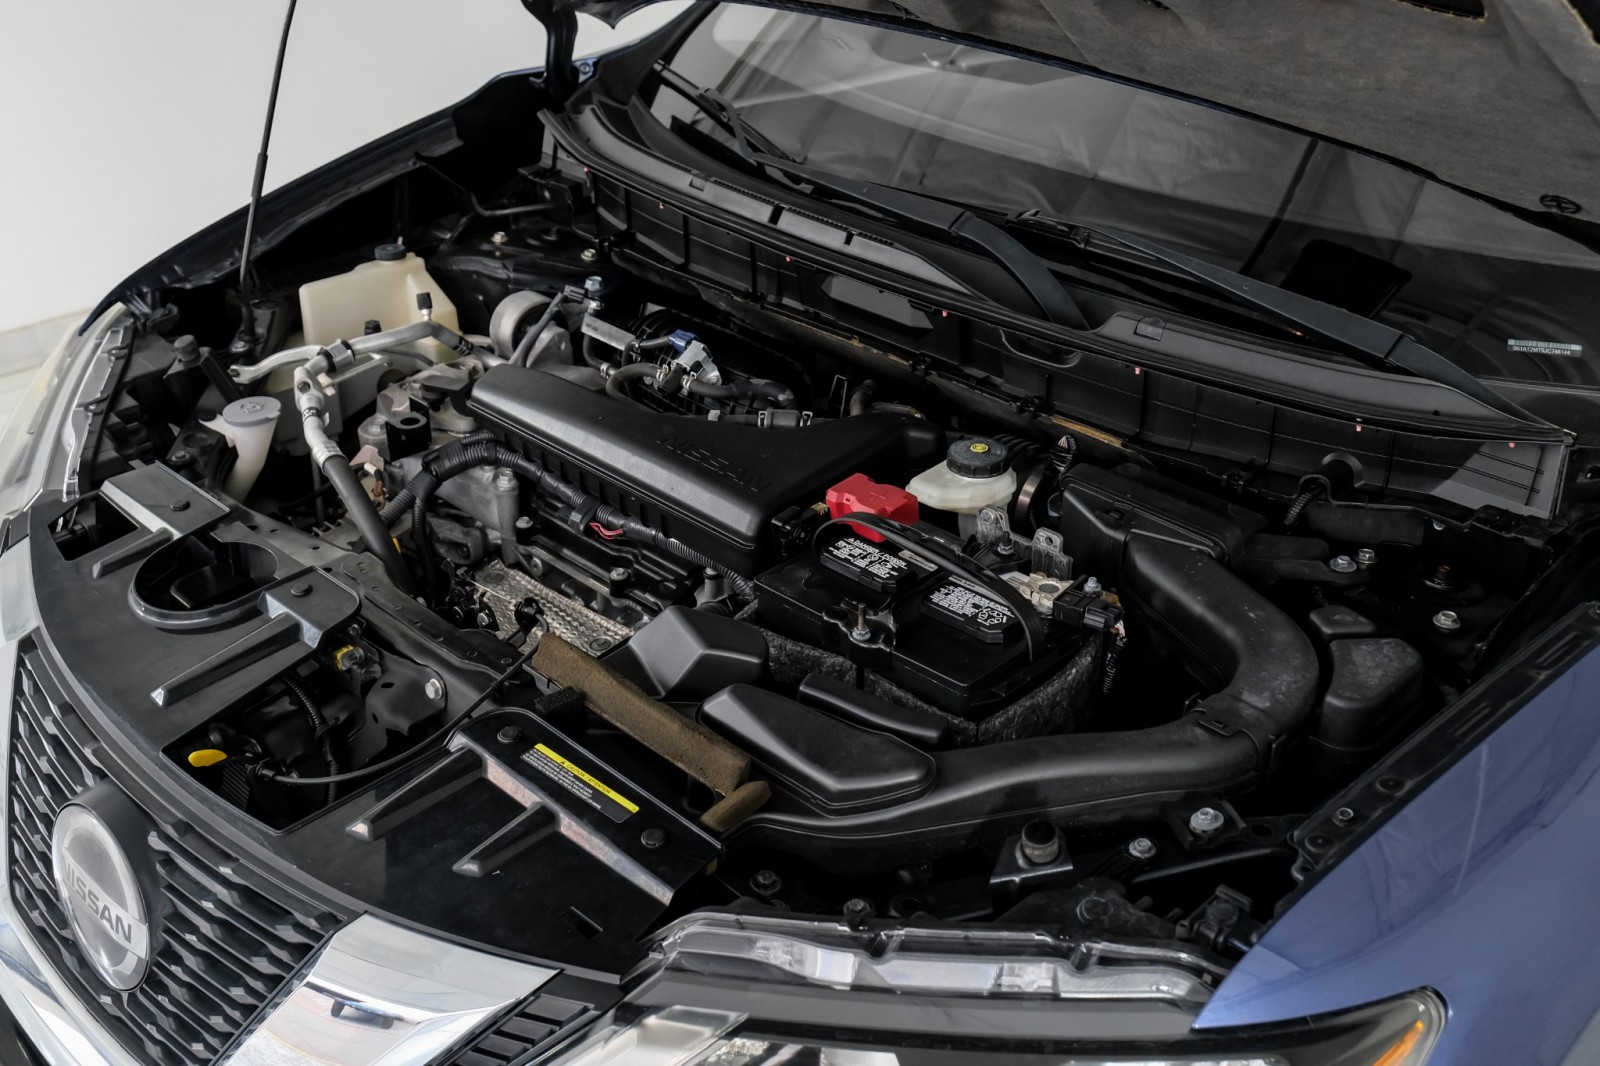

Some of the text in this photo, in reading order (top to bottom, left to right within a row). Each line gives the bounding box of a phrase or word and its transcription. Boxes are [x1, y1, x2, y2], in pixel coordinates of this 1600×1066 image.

[854, 540, 879, 553] DANGER
[882, 554, 907, 566] POISON
[567, 764, 585, 778] CAUTION
[588, 778, 611, 794] ATTENTION
[63, 858, 132, 944] NISSAN
